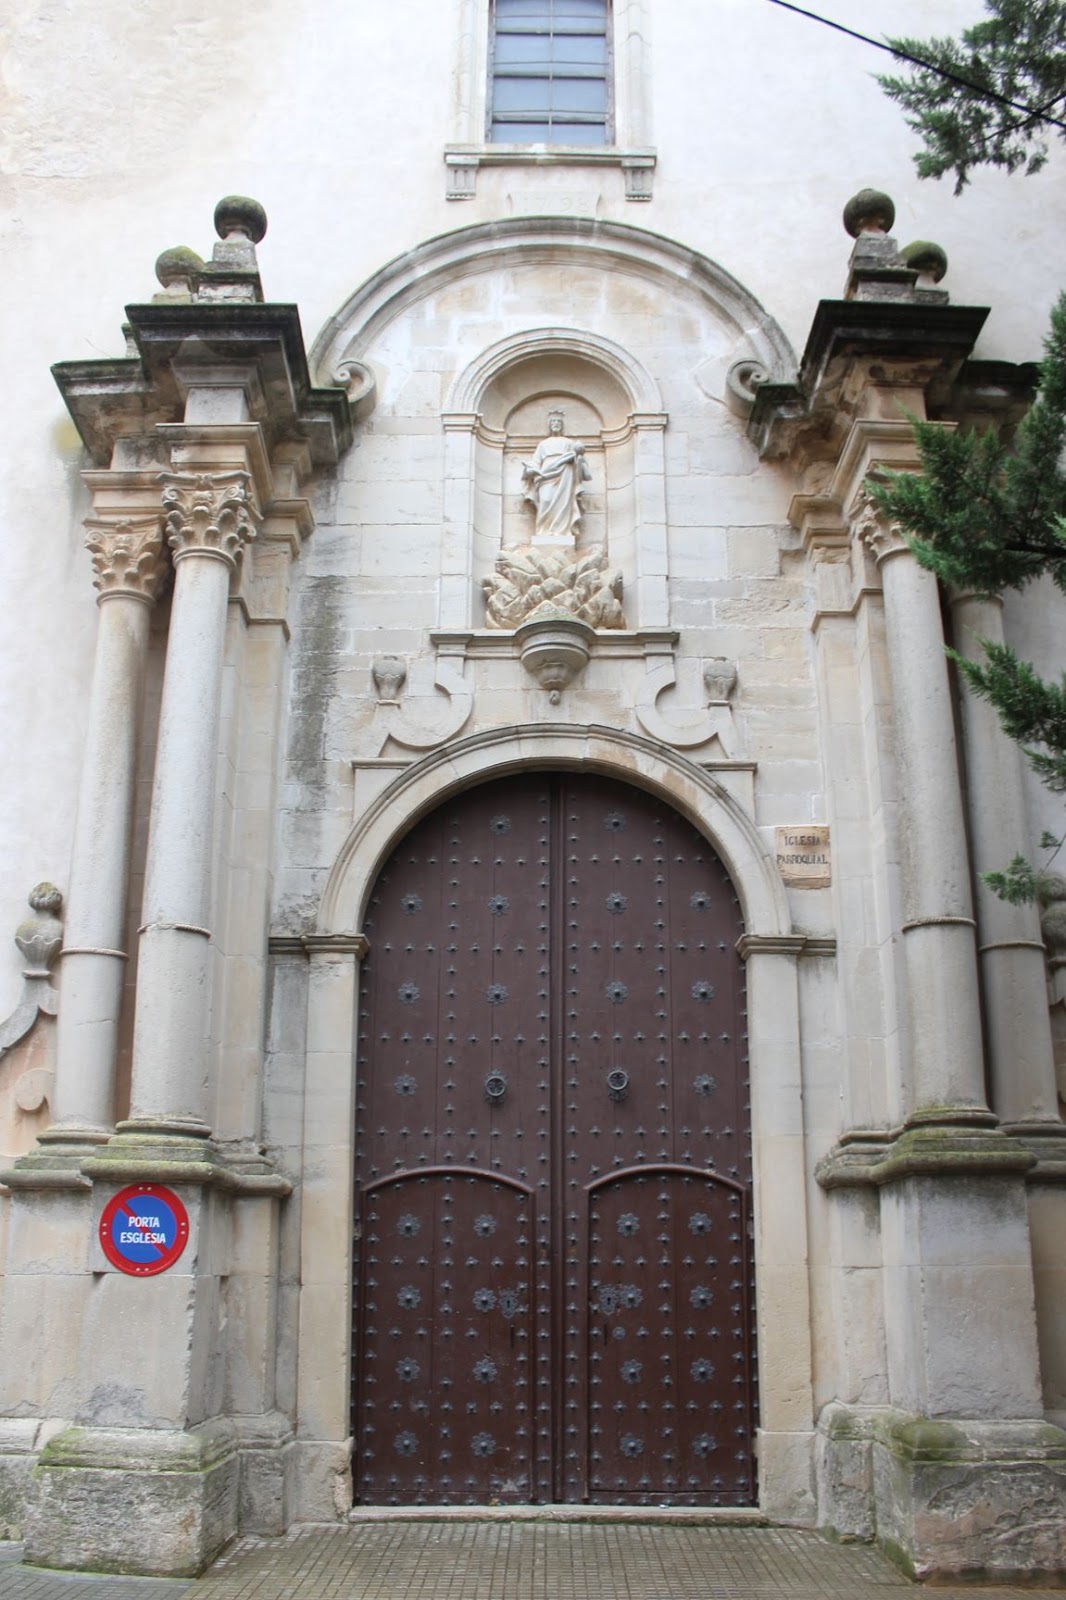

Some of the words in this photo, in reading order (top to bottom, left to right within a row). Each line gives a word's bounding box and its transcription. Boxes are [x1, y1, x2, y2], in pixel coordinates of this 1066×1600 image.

[784, 836, 821, 846] IGLESIA
[128, 1216, 160, 1227] PORTA
[120, 1232, 166, 1243] ESGLESIA
